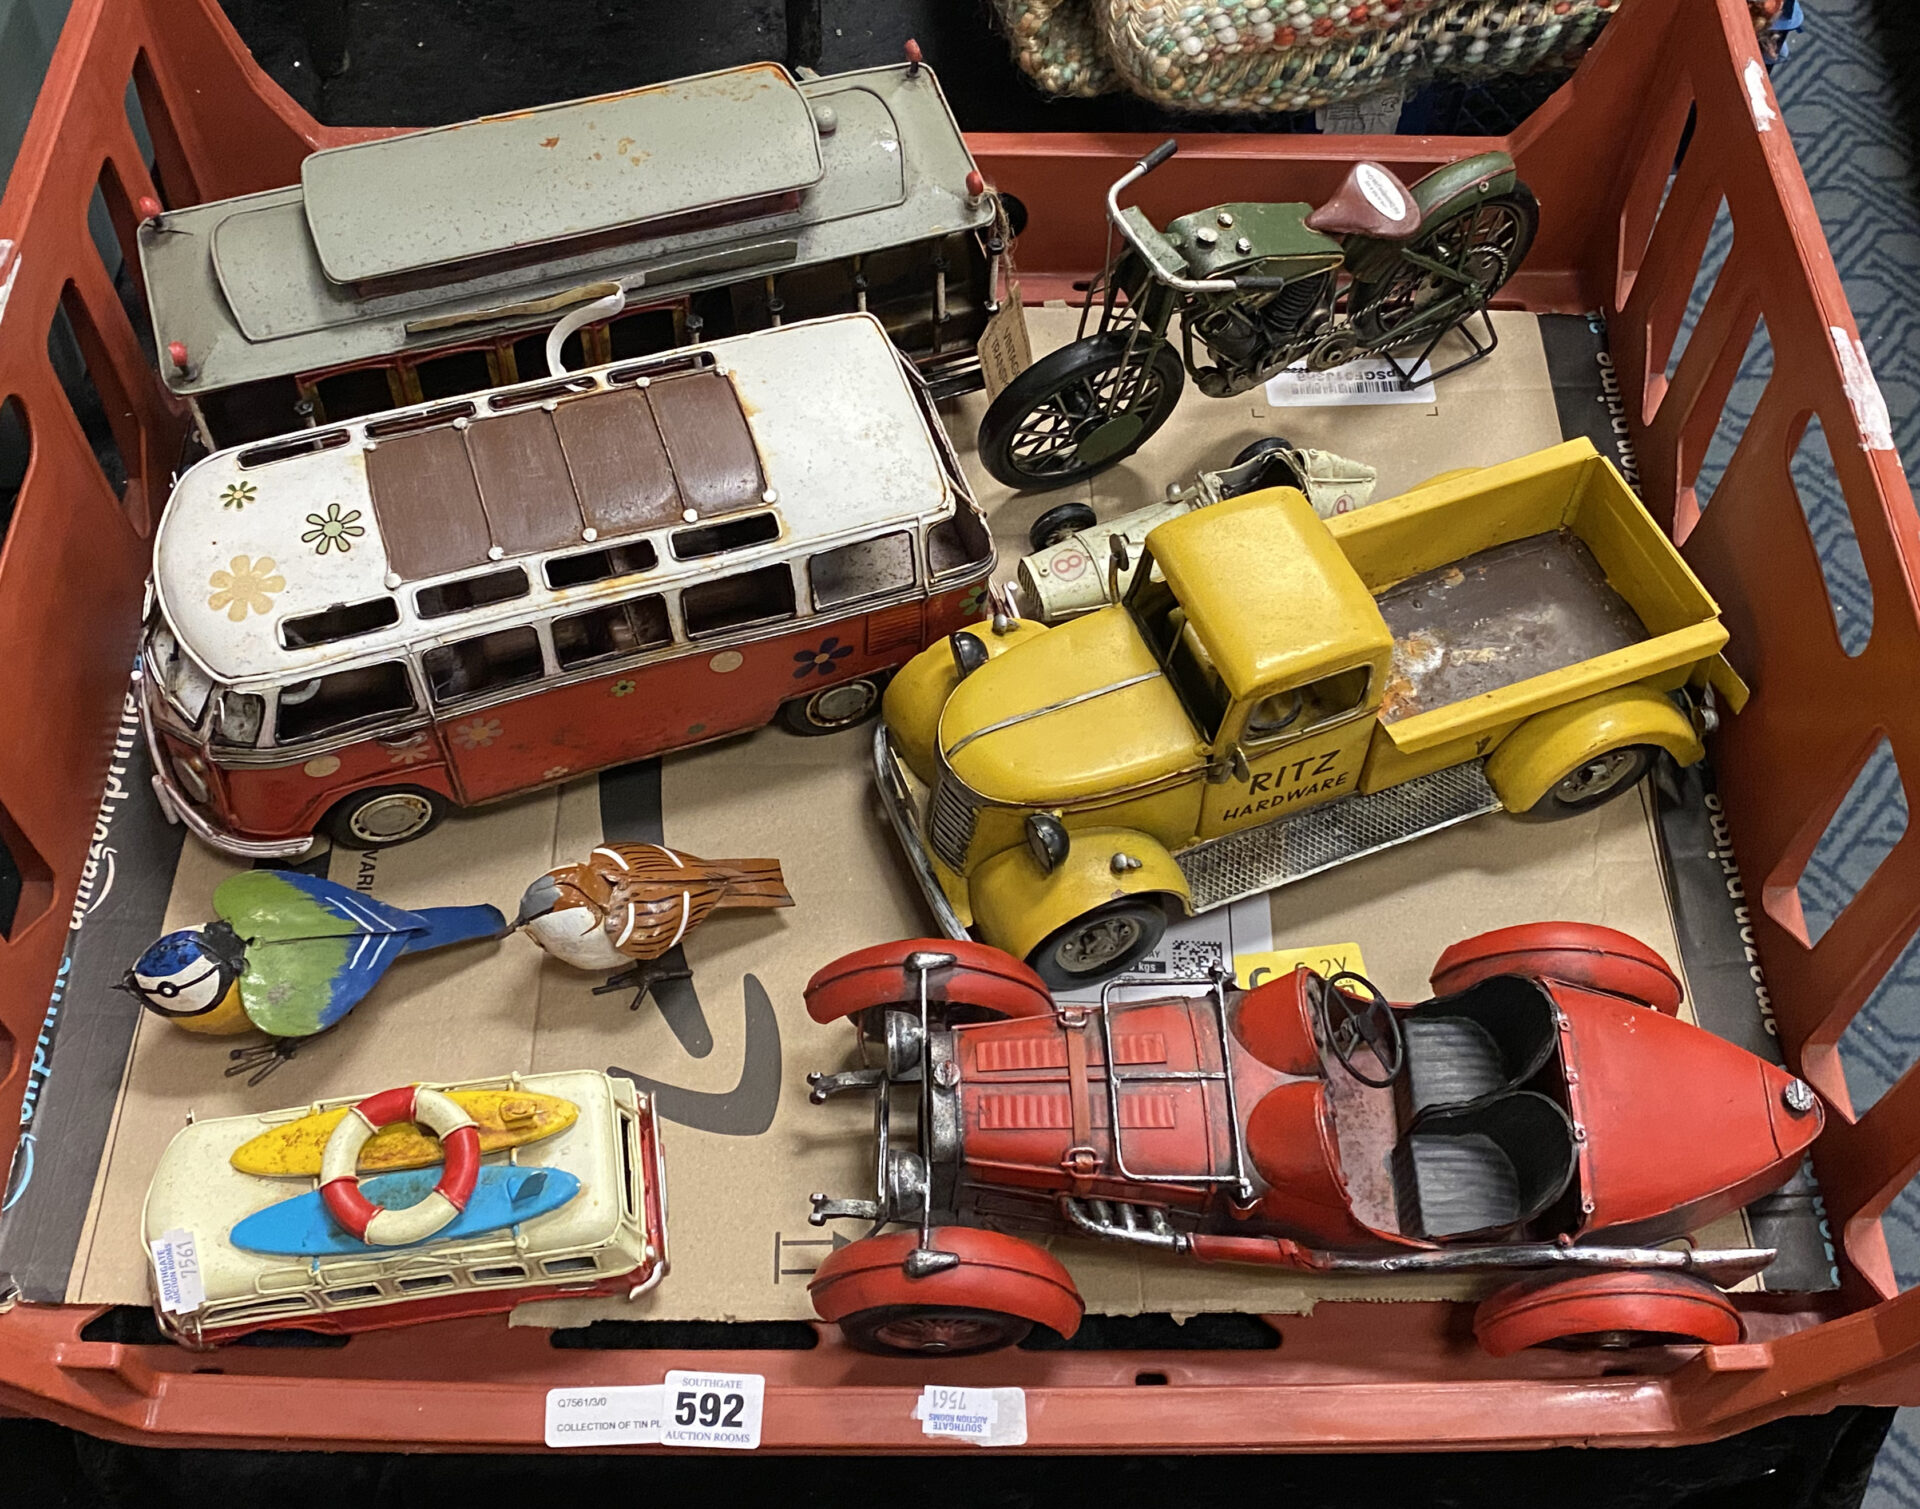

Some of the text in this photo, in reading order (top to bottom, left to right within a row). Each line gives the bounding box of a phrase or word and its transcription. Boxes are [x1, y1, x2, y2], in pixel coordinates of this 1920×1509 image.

[1054, 555, 1082, 573] 8
[1249, 749, 1341, 795] RITZ
[1223, 771, 1349, 821] HARDWARE
[176, 1240, 198, 1279] 7561
[157, 1249, 174, 1302] SOUTHGATE
[165, 1243, 182, 1304] AUCTION ROOMS
[682, 1376, 744, 1389] SOUTHGATE
[557, 1397, 607, 1409] Q7561/3/0
[932, 1389, 967, 1410] 7561
[675, 1391, 745, 1428] 592
[928, 1413, 988, 1424] AUCTION ROOMS
[557, 1422, 616, 1432] COLLECTION
[618, 1421, 631, 1430] OF
[633, 1420, 648, 1429] TIN
[932, 1421, 983, 1433] SOUTHGATE
[665, 1431, 750, 1443] AUCTION ROOMS
